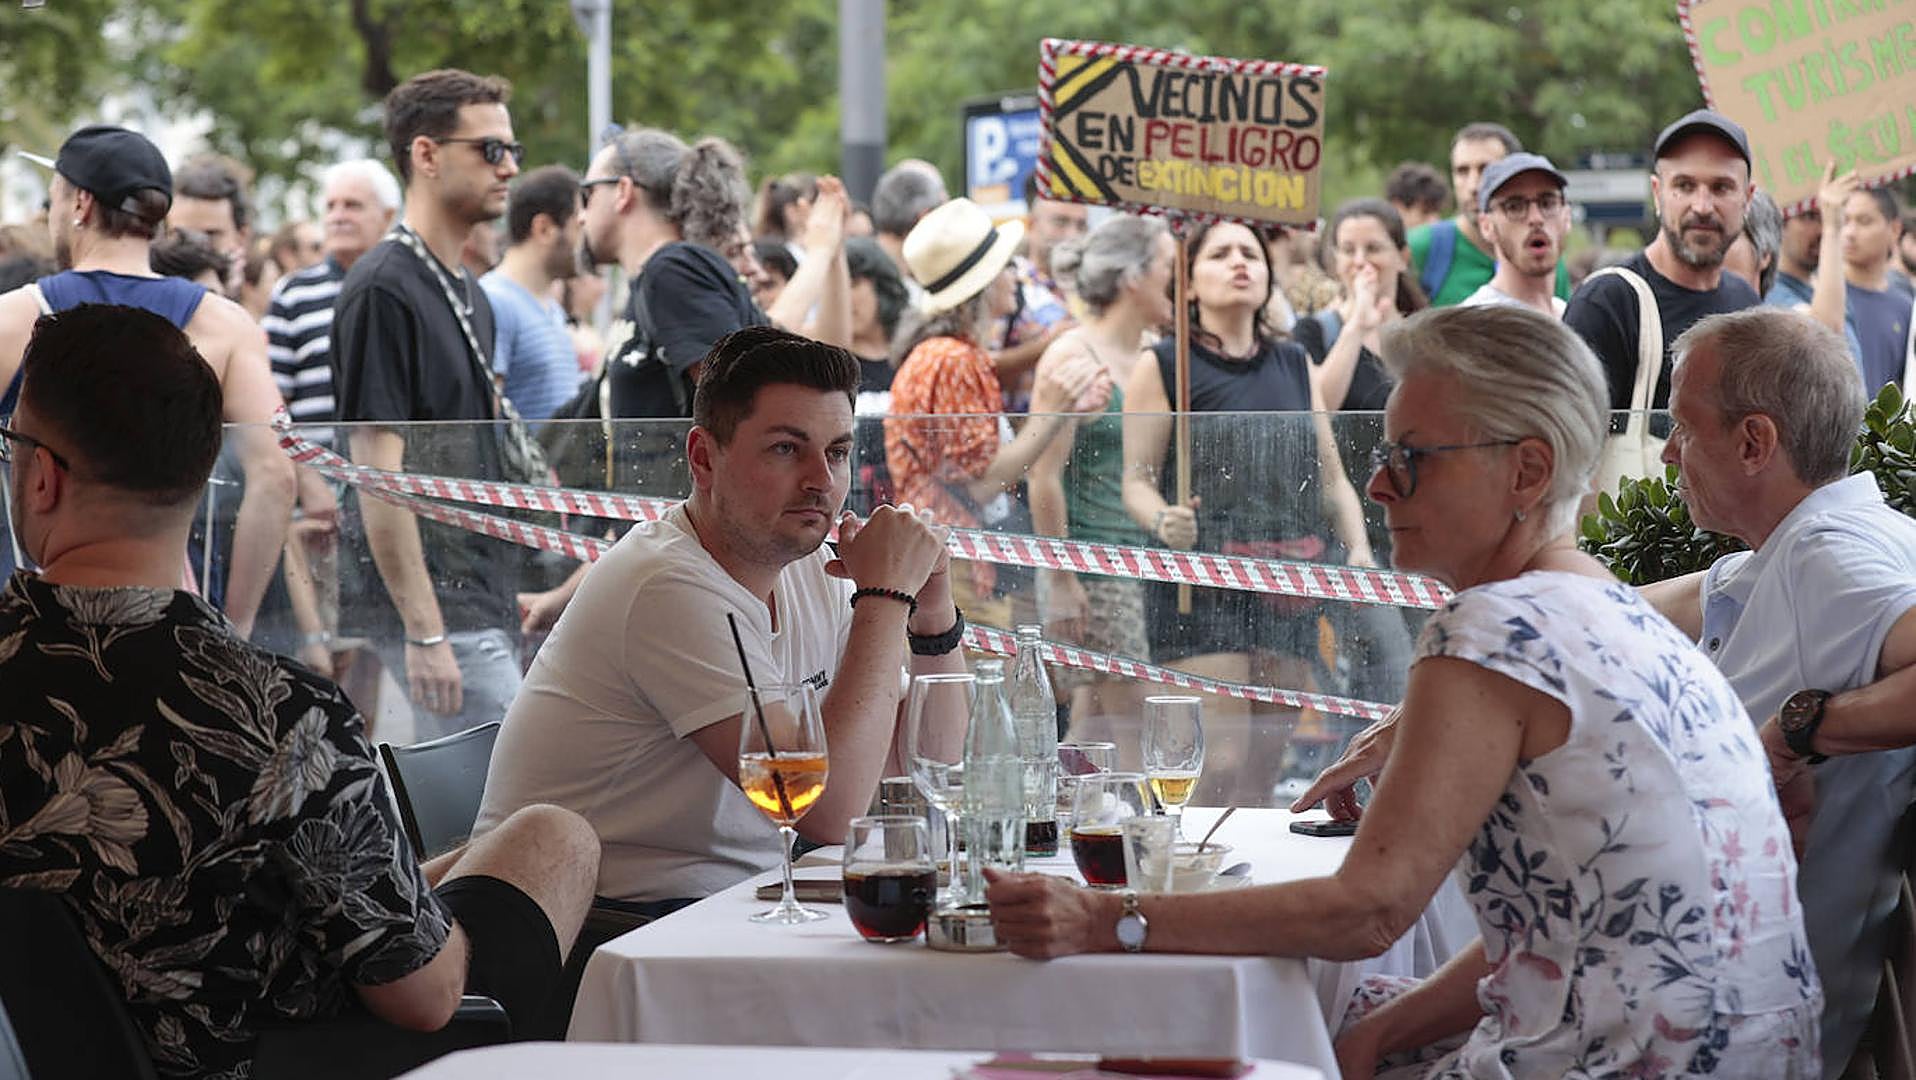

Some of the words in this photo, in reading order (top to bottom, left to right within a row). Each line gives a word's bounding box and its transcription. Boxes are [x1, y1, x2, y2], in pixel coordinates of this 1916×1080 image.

[1128, 65, 1320, 128] VECINOS
[1076, 111, 1134, 152] EN
[1144, 119, 1320, 172] PELIGRO
[1100, 154, 1134, 186] DE
[1137, 160, 1306, 209] EXTINCION
